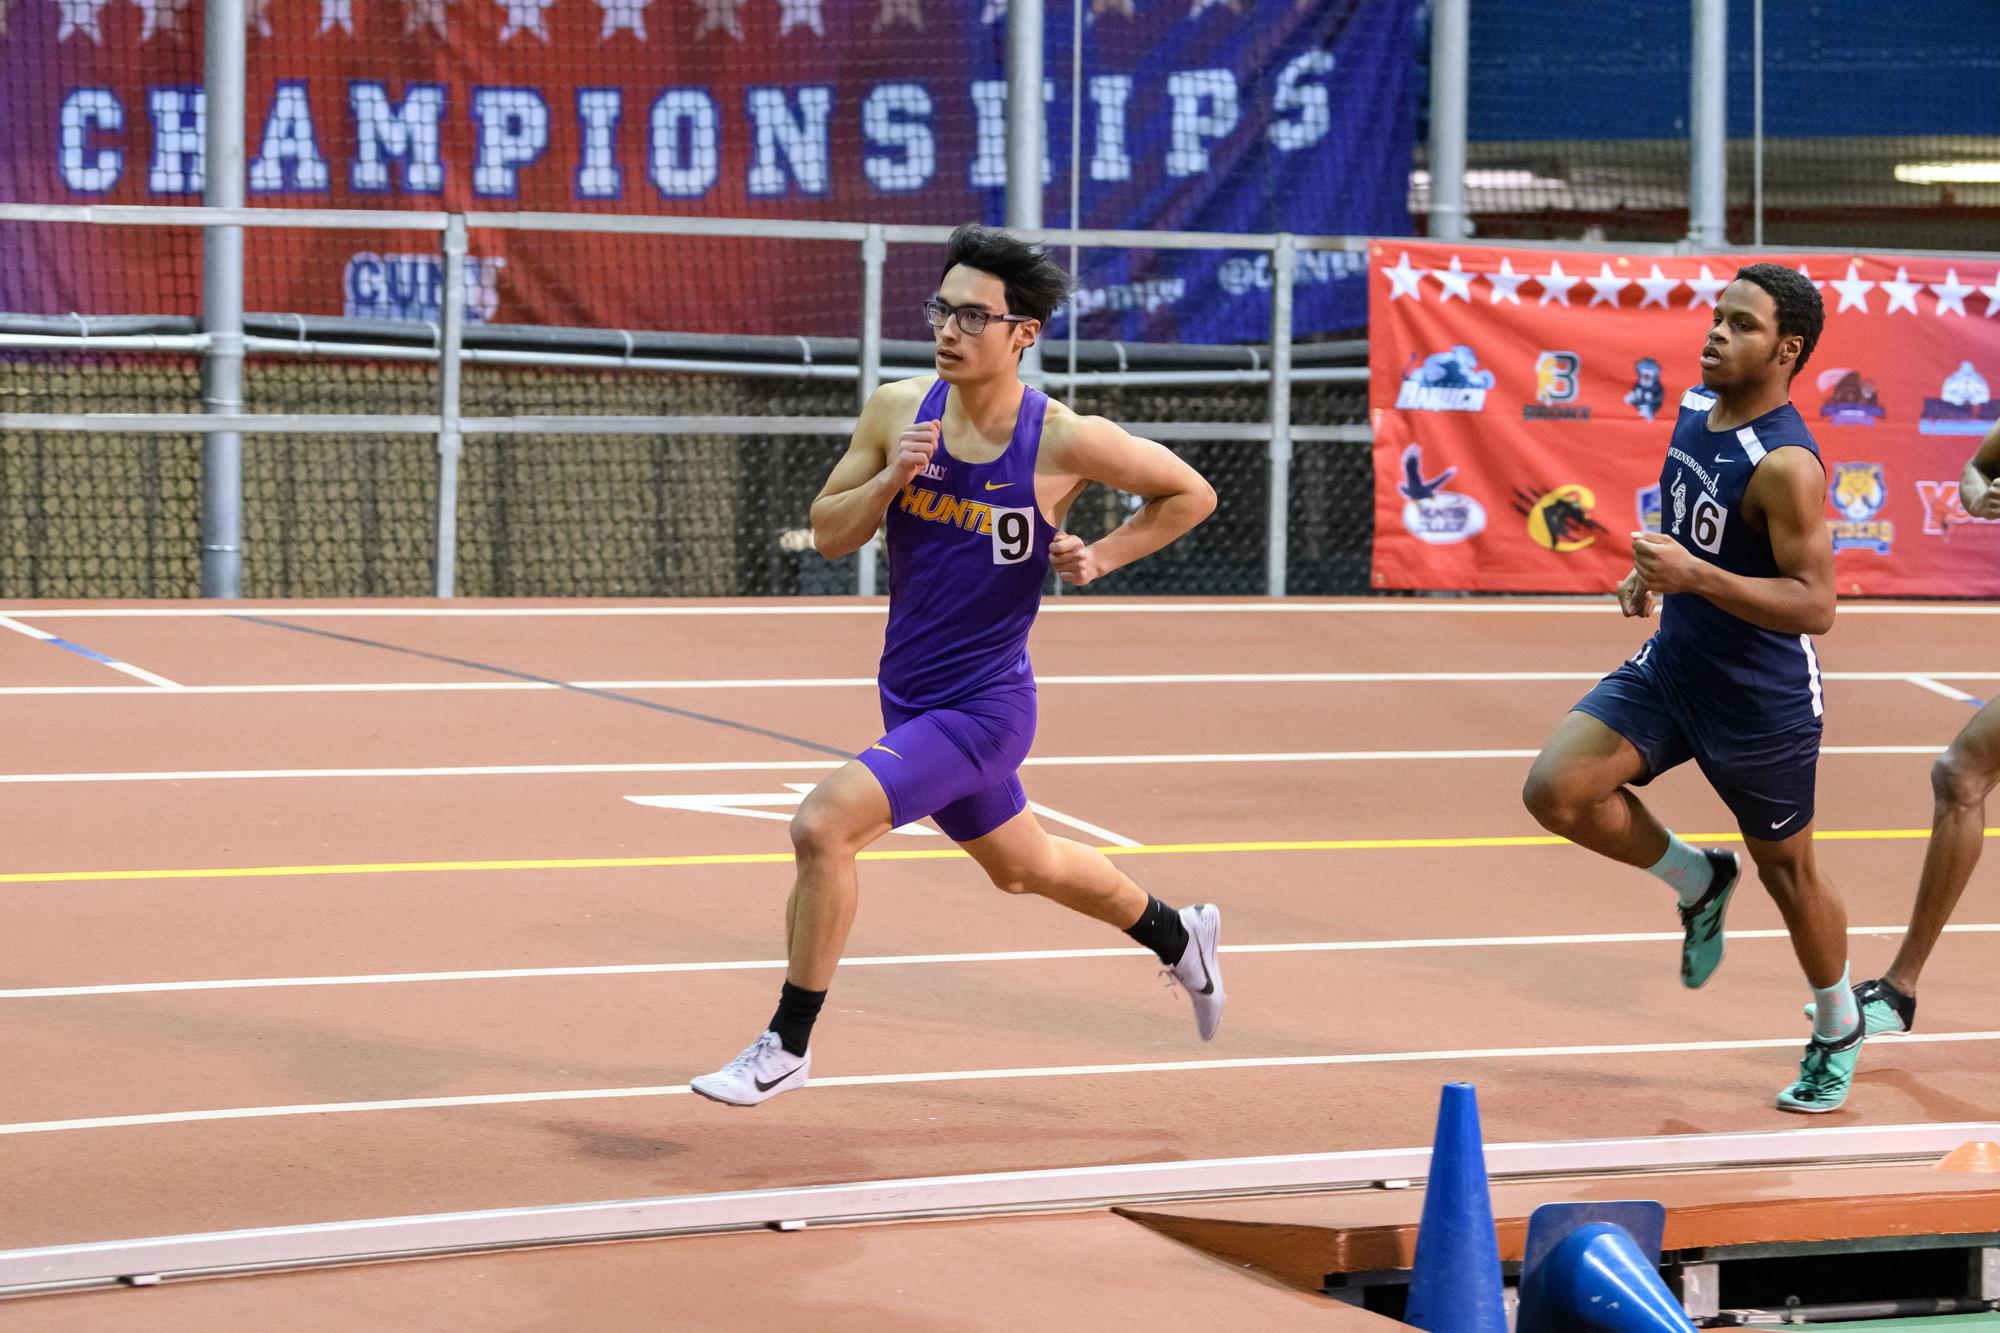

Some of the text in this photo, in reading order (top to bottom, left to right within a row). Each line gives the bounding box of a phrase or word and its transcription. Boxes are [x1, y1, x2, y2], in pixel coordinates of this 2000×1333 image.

[1668, 446, 1719, 498] QUEENSBOROUGH
[997, 511, 1030, 561] 9
[1694, 500, 1720, 547] 6
